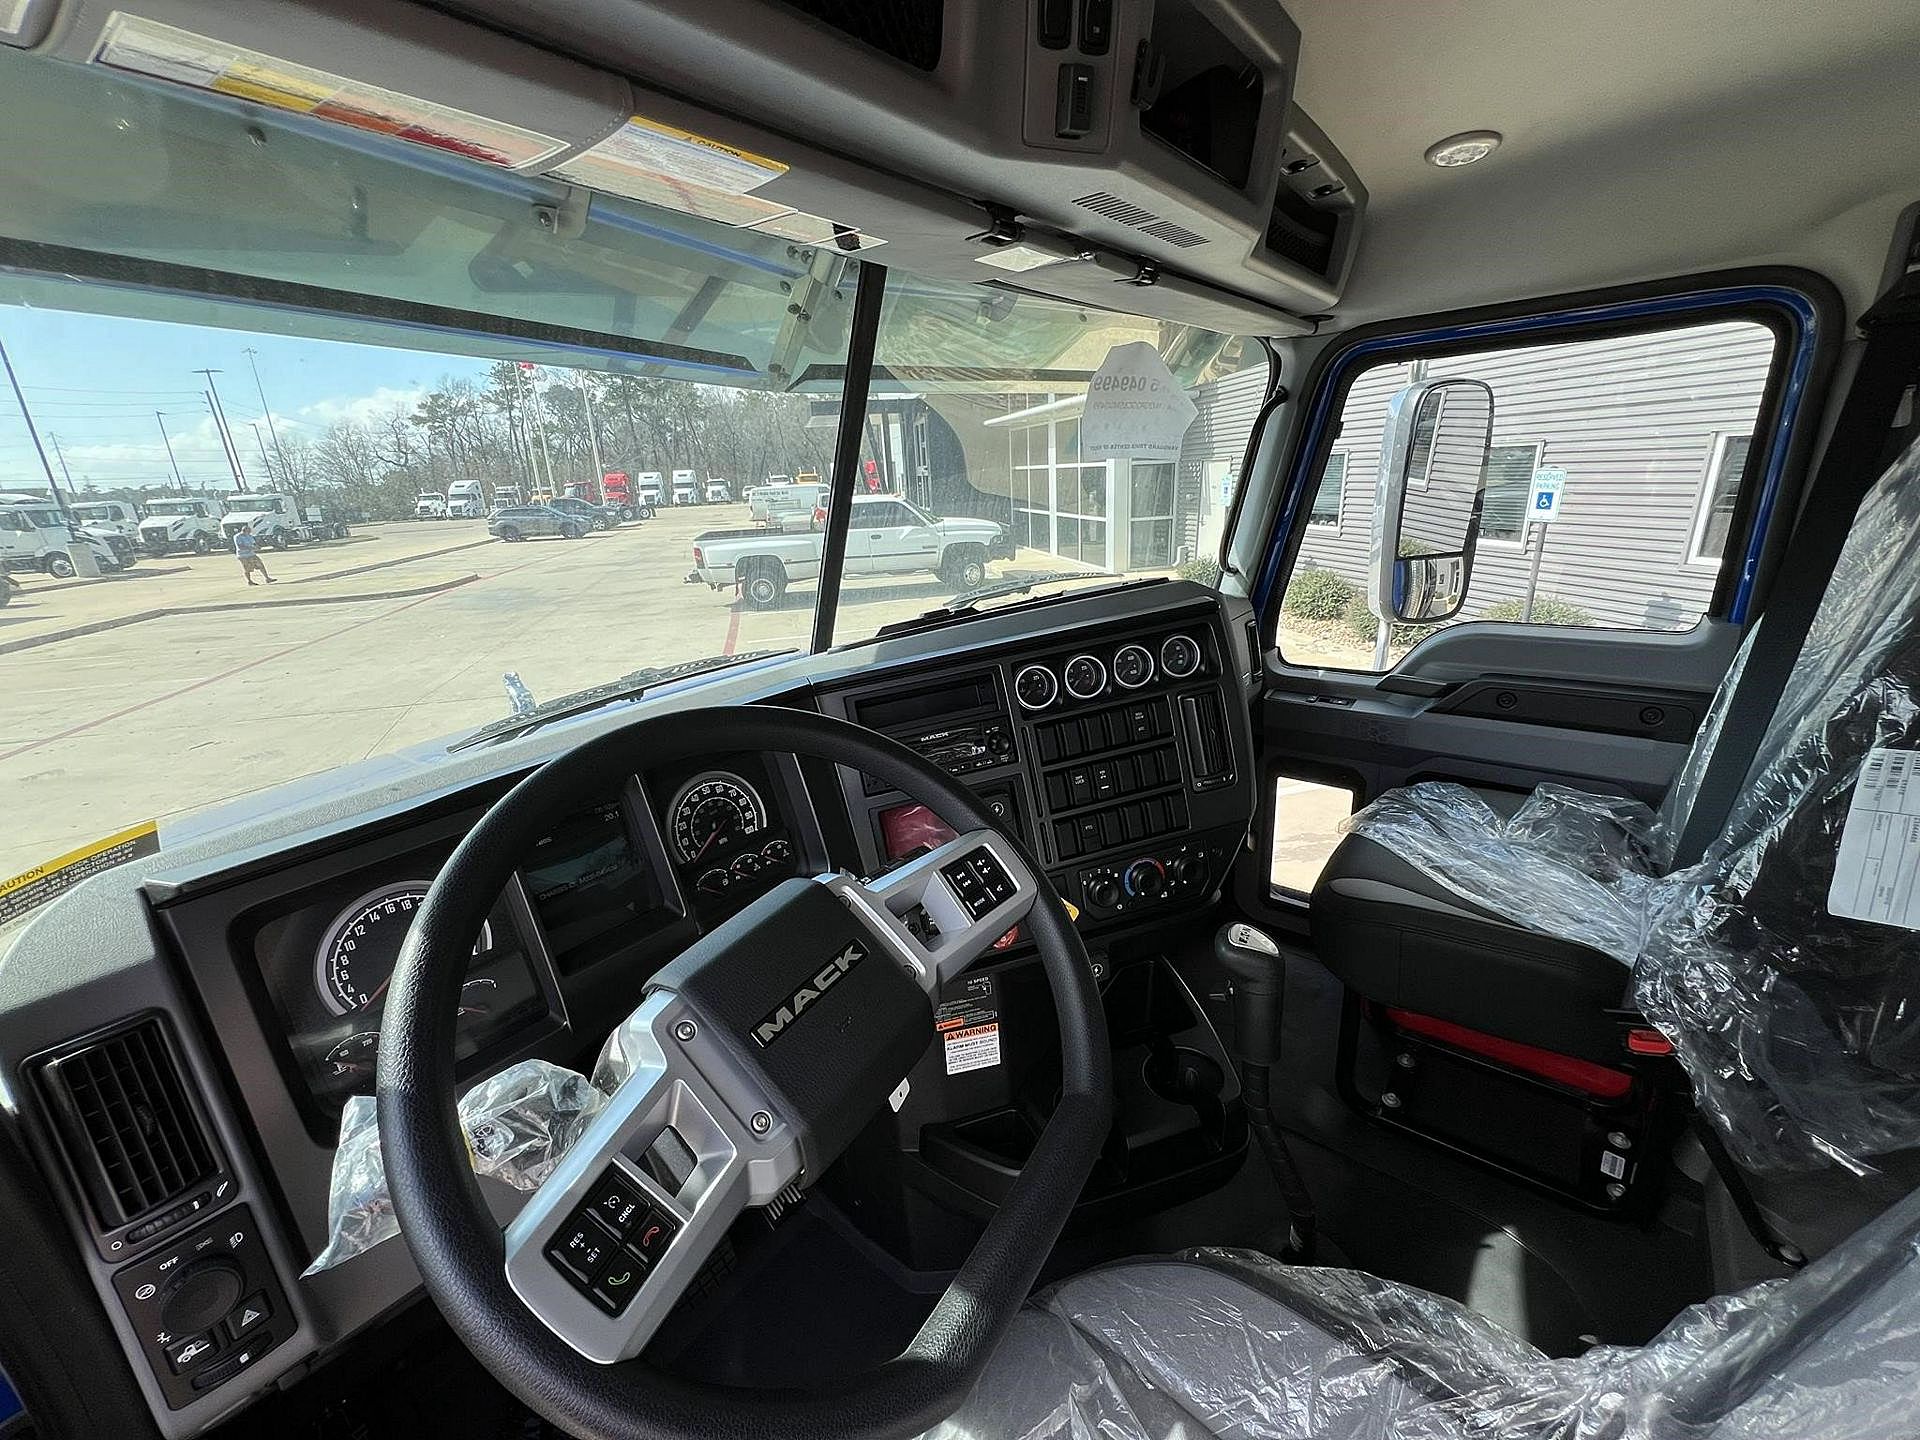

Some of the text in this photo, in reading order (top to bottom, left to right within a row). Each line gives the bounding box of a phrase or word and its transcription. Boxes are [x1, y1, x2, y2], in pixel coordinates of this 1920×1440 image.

[921, 731, 949, 741] MACK
[702, 786, 711, 795] 50
[728, 788, 738, 797] 70
[682, 807, 691, 816] 30
[91, 840, 136, 861] OPERATION
[69, 861, 115, 883] OPERATION
[70, 857, 107, 876] TRACTOR
[384, 903, 397, 915] 16
[400, 899, 413, 912] 18
[368, 911, 381, 924] 14
[354, 924, 367, 937] 12
[344, 940, 356, 952] 10
[340, 955, 350, 966] 8
[340, 970, 350, 981] 6
[347, 984, 355, 994] 4
[757, 945, 863, 1042] MACK
[359, 993, 368, 1005] 0
[956, 1024, 997, 1040] WARNING
[618, 1203, 635, 1222] CNCL
[570, 1232, 584, 1248] RES
[587, 1247, 600, 1262] SET
[159, 1256, 180, 1270] OFF
